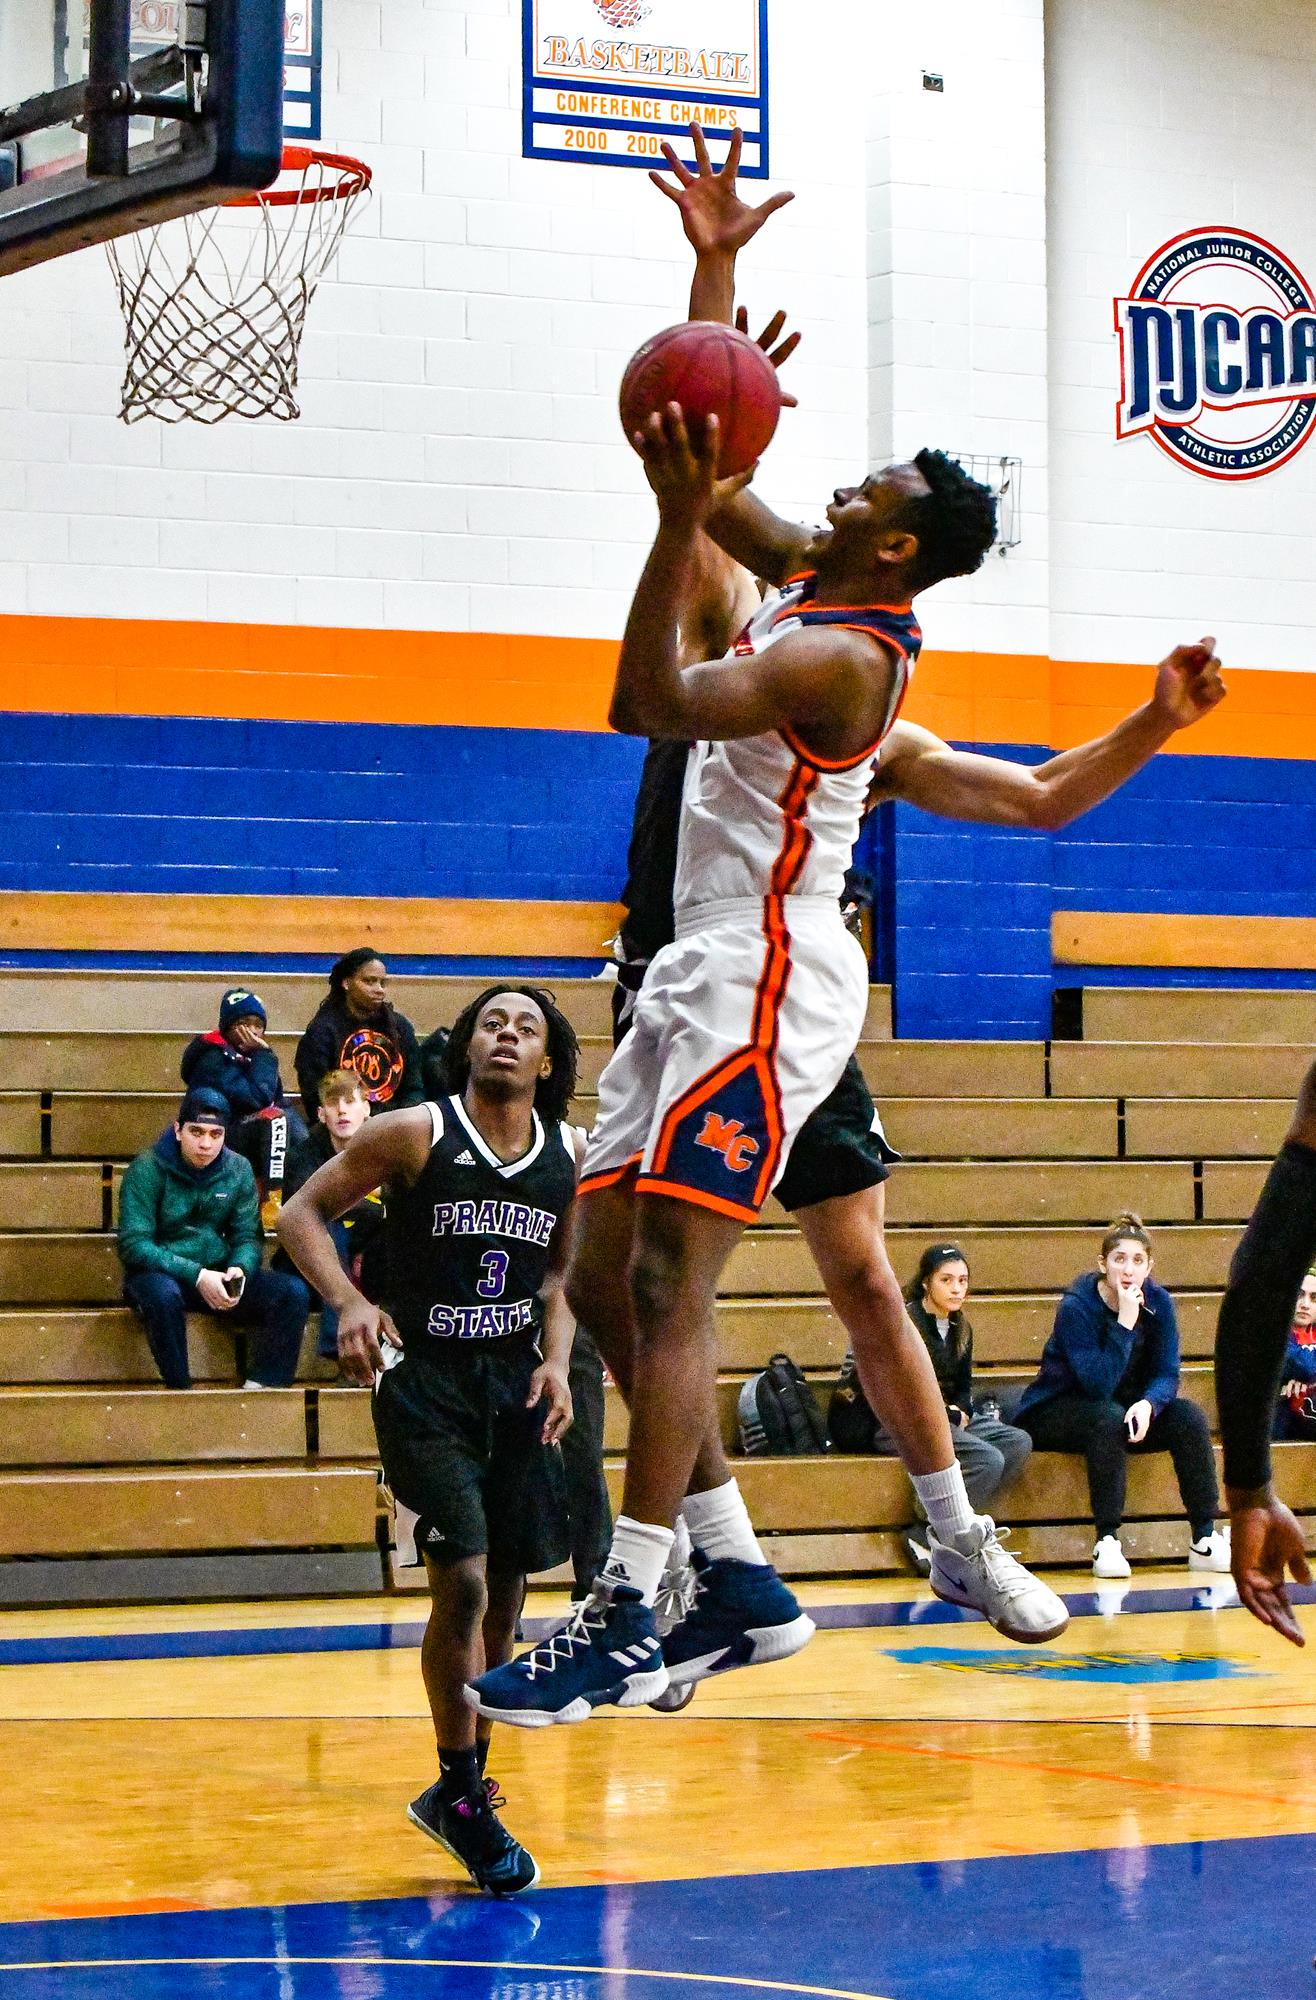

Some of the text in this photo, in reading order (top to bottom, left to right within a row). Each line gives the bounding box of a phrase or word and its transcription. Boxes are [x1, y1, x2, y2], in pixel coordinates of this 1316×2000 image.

[544, 36, 751, 83] BASKETBALL
[556, 92, 738, 127] CONFERENCE CHAMPS
[564, 129, 607, 150] 2000
[1147, 244, 1303, 307] NATIONAL JUNIOR COLLEGE
[1126, 305, 1316, 420] NJCAA
[1177, 404, 1309, 466] ATHLETIC ASSOCIATION
[694, 1111, 760, 1172] MC
[432, 1200, 557, 1247] PRAIRIE
[476, 1250, 510, 1298] 3
[428, 1298, 534, 1339] STATE
